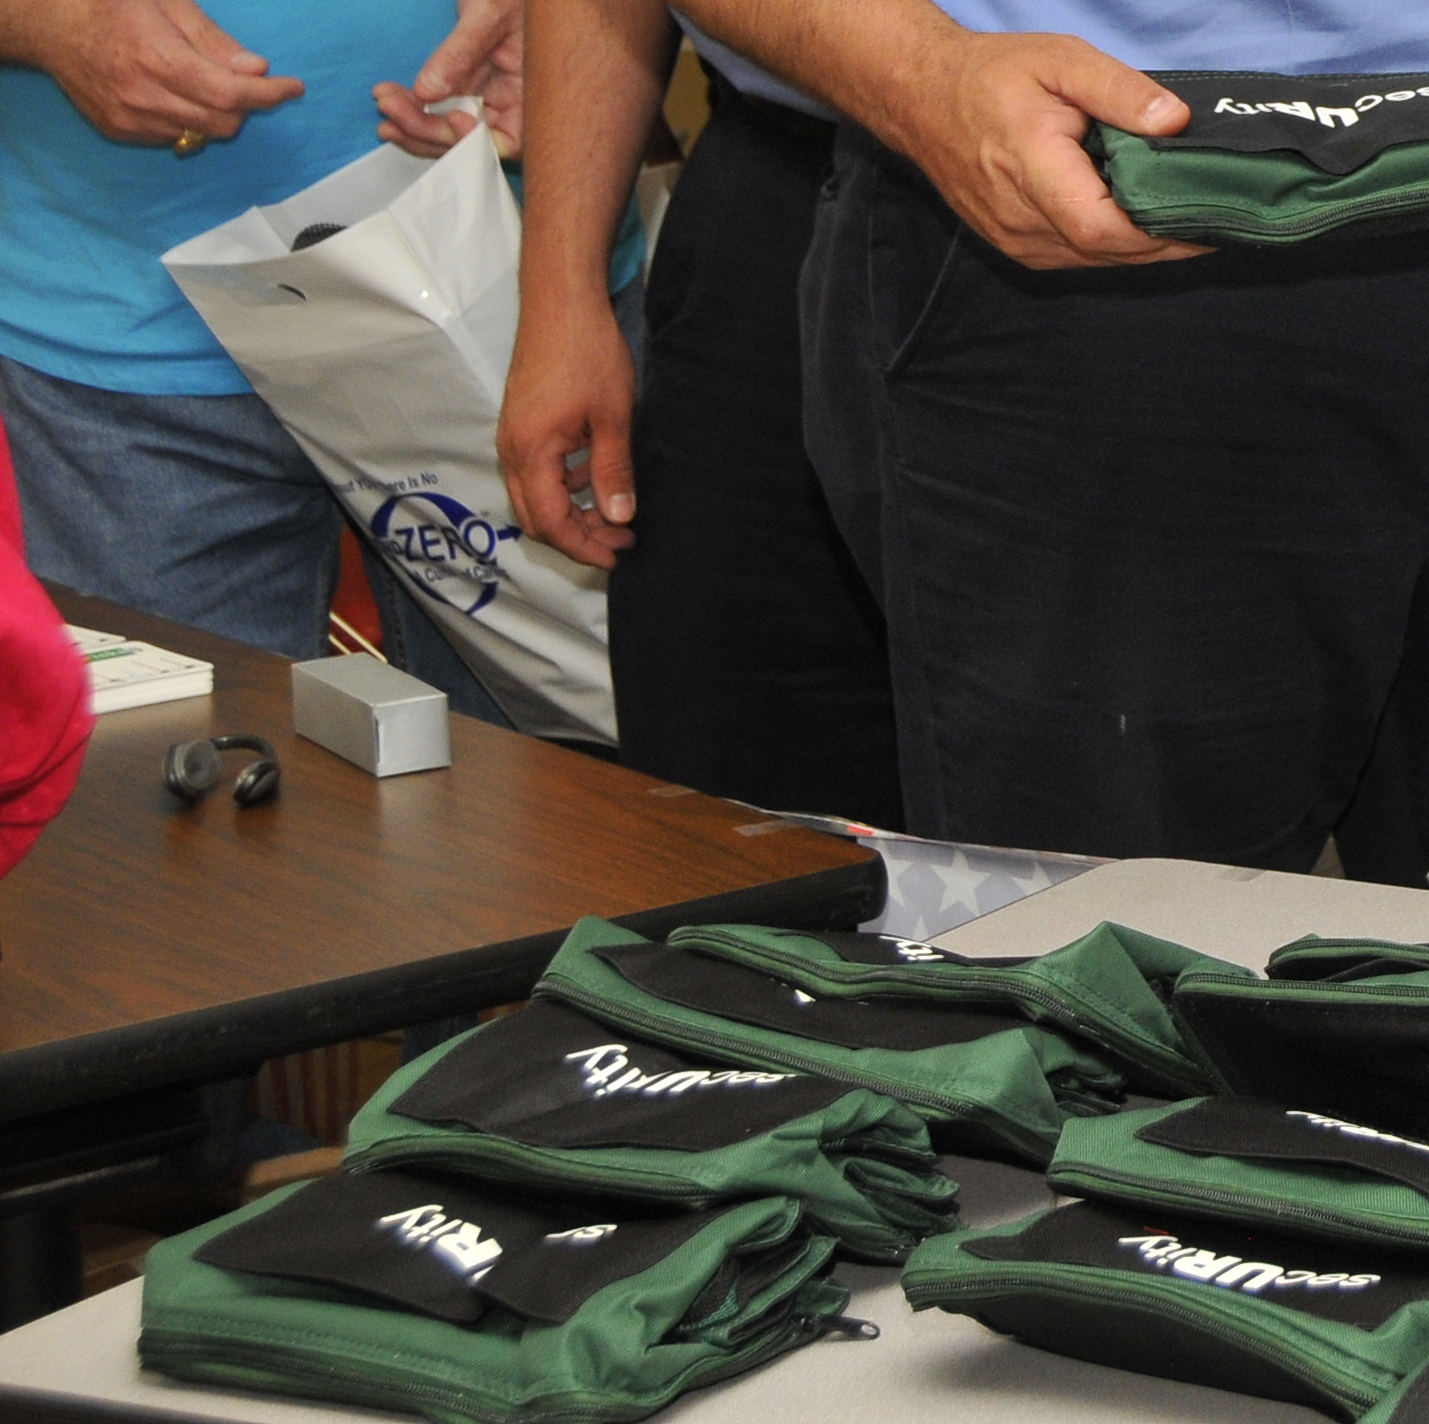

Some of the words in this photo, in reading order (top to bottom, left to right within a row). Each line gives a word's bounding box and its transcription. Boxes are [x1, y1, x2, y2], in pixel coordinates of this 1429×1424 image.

[420, 471, 439, 486] No
[394, 519, 497, 563] ZERO
[1118, 1234, 1382, 1300] secURity
